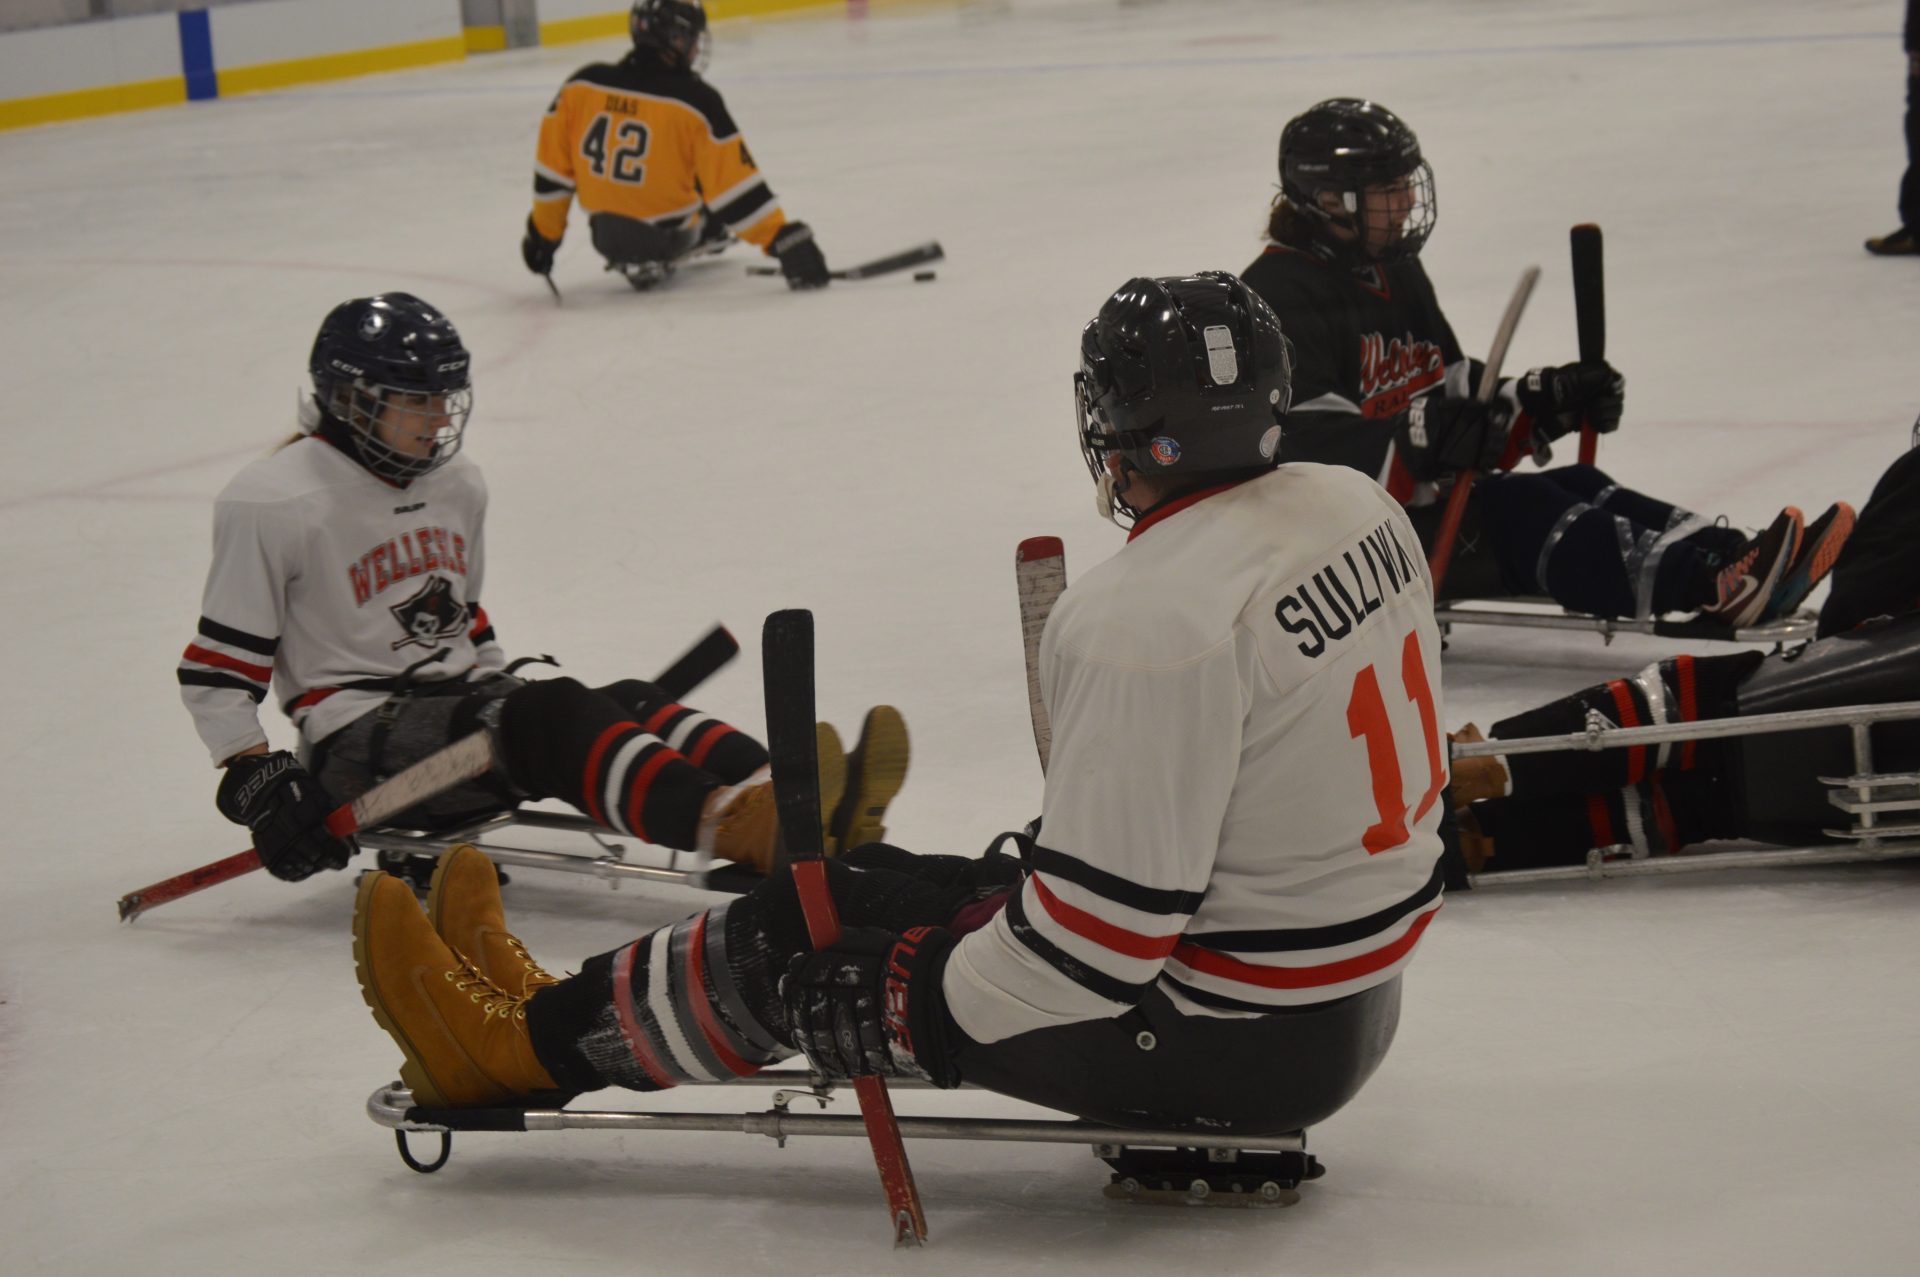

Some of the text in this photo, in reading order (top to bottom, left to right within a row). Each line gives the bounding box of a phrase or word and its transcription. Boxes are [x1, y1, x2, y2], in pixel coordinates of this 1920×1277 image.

[581, 114, 649, 186] 42
[331, 358, 364, 376] CCM
[1275, 517, 1419, 659] SULLIVN
[1346, 628, 1447, 856] 11
